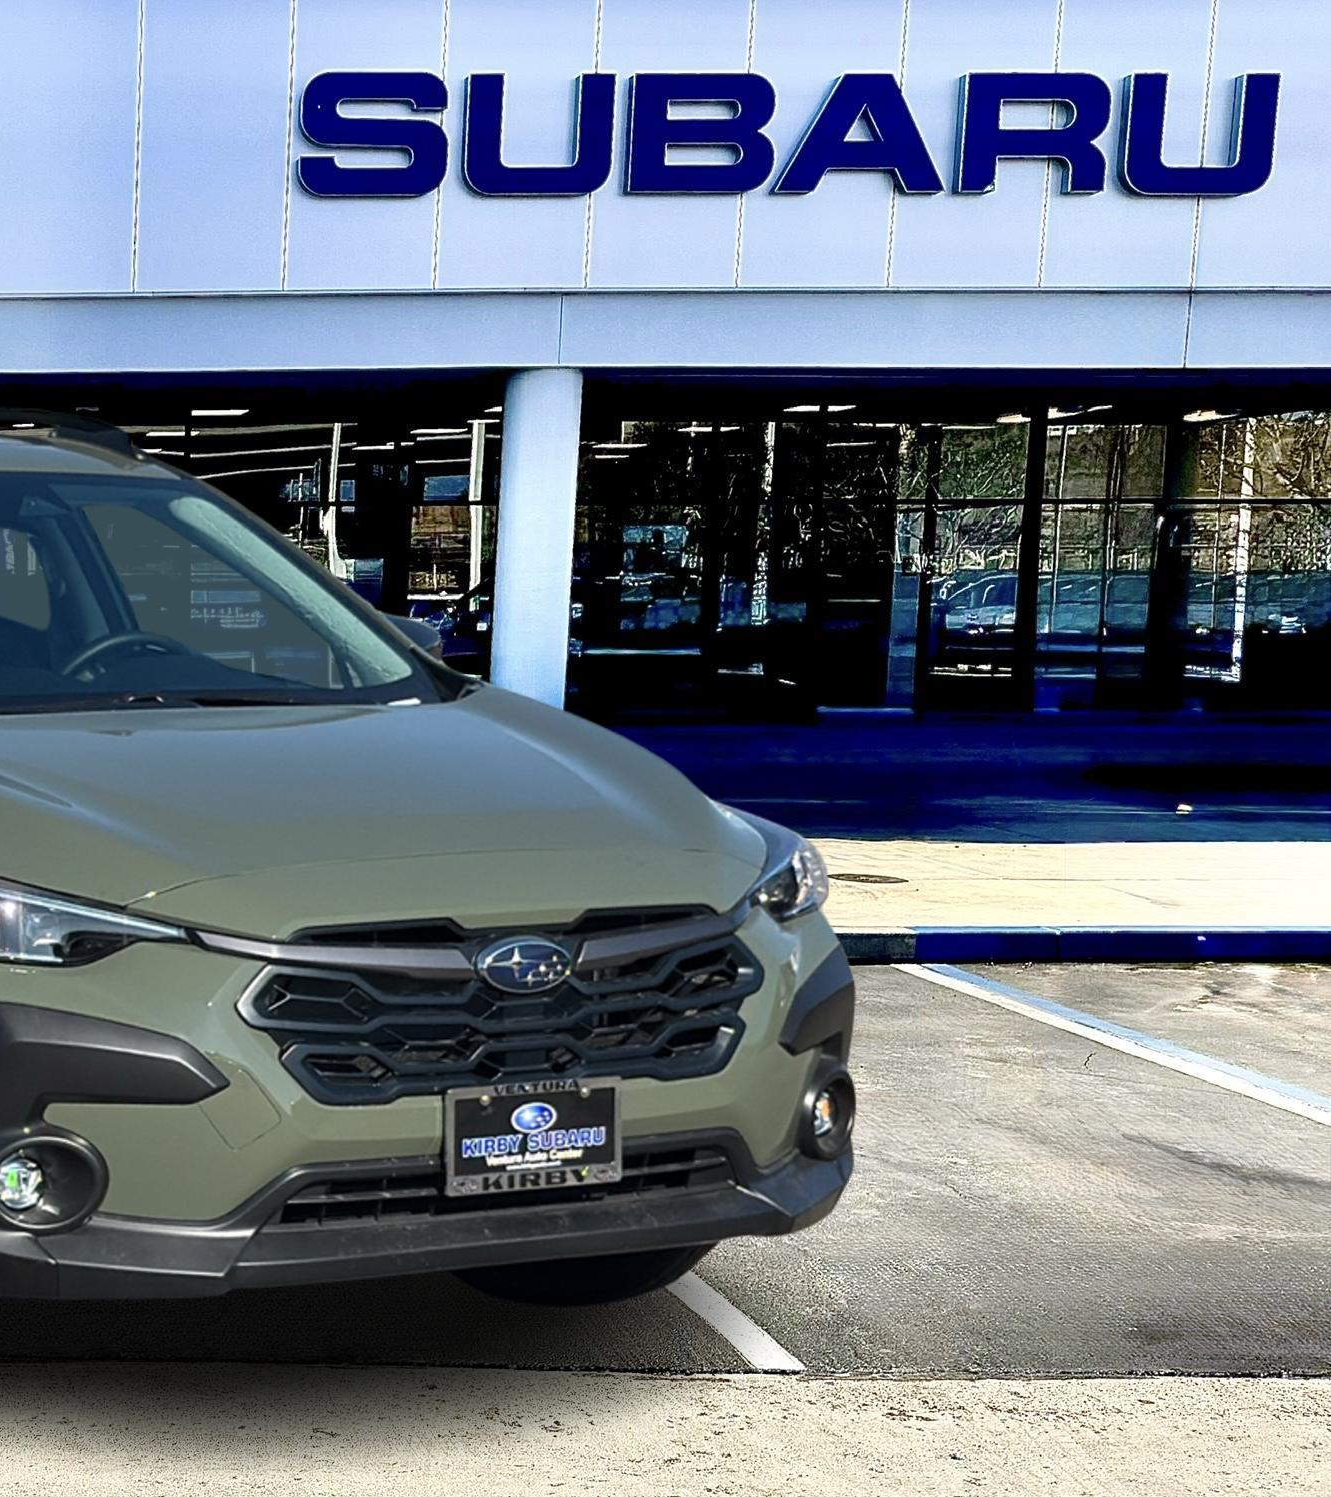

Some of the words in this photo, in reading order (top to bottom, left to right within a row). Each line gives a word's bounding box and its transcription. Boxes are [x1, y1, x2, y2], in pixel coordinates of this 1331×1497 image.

[297, 71, 1281, 198] SUBARU
[494, 1079, 580, 1096] VENTURA
[462, 1134, 523, 1158] KIRBY
[527, 1127, 606, 1151] SUBARU
[482, 1167, 589, 1191] KIRBY
